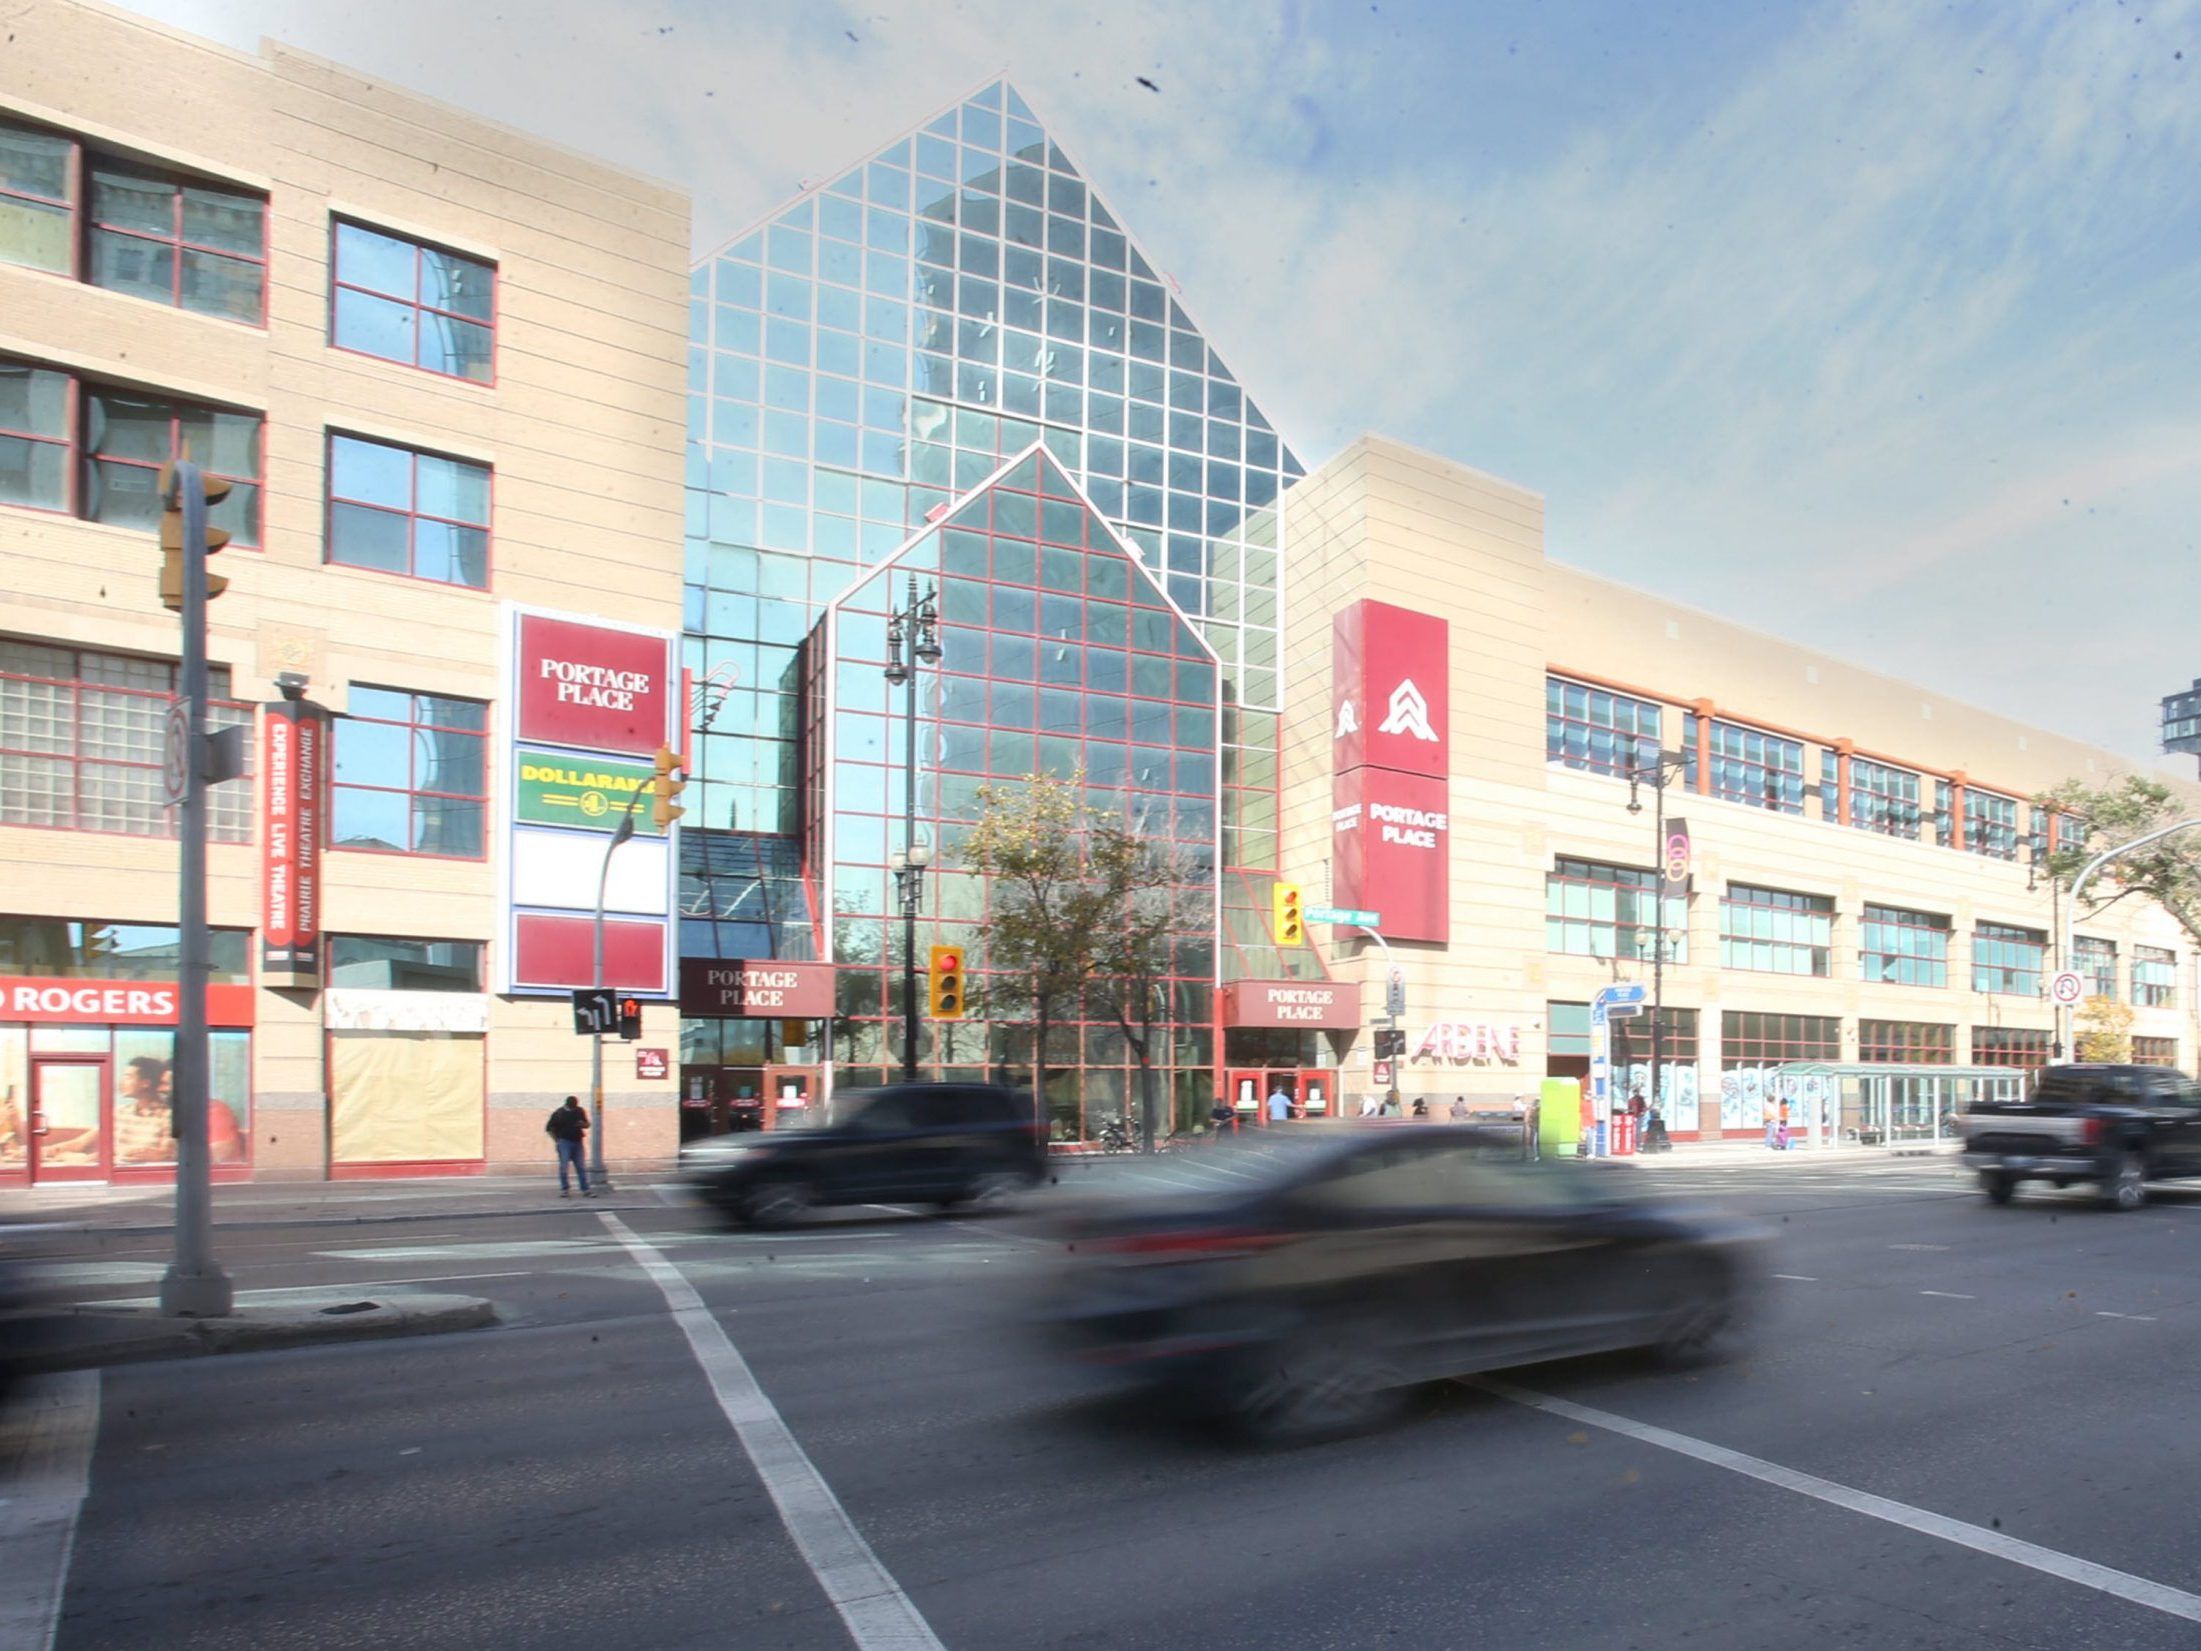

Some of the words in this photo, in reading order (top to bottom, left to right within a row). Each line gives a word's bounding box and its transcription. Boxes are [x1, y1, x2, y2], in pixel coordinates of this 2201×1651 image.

[540, 658, 649, 694] PORTAGE
[557, 682, 634, 711] PLACE
[271, 723, 288, 815] EXPERIENCE
[1370, 803, 1447, 830] PORTAGE
[270, 823, 287, 858] LIVE
[1382, 825, 1436, 848] PLACE
[270, 864, 286, 930] THEATRE
[707, 969, 798, 988] PORTAGE
[13, 986, 174, 1015] ROGERS
[720, 989, 784, 1006] PLACE
[1267, 988, 1333, 1004] PORTAGE
[1277, 1005, 1323, 1020] PLACE
